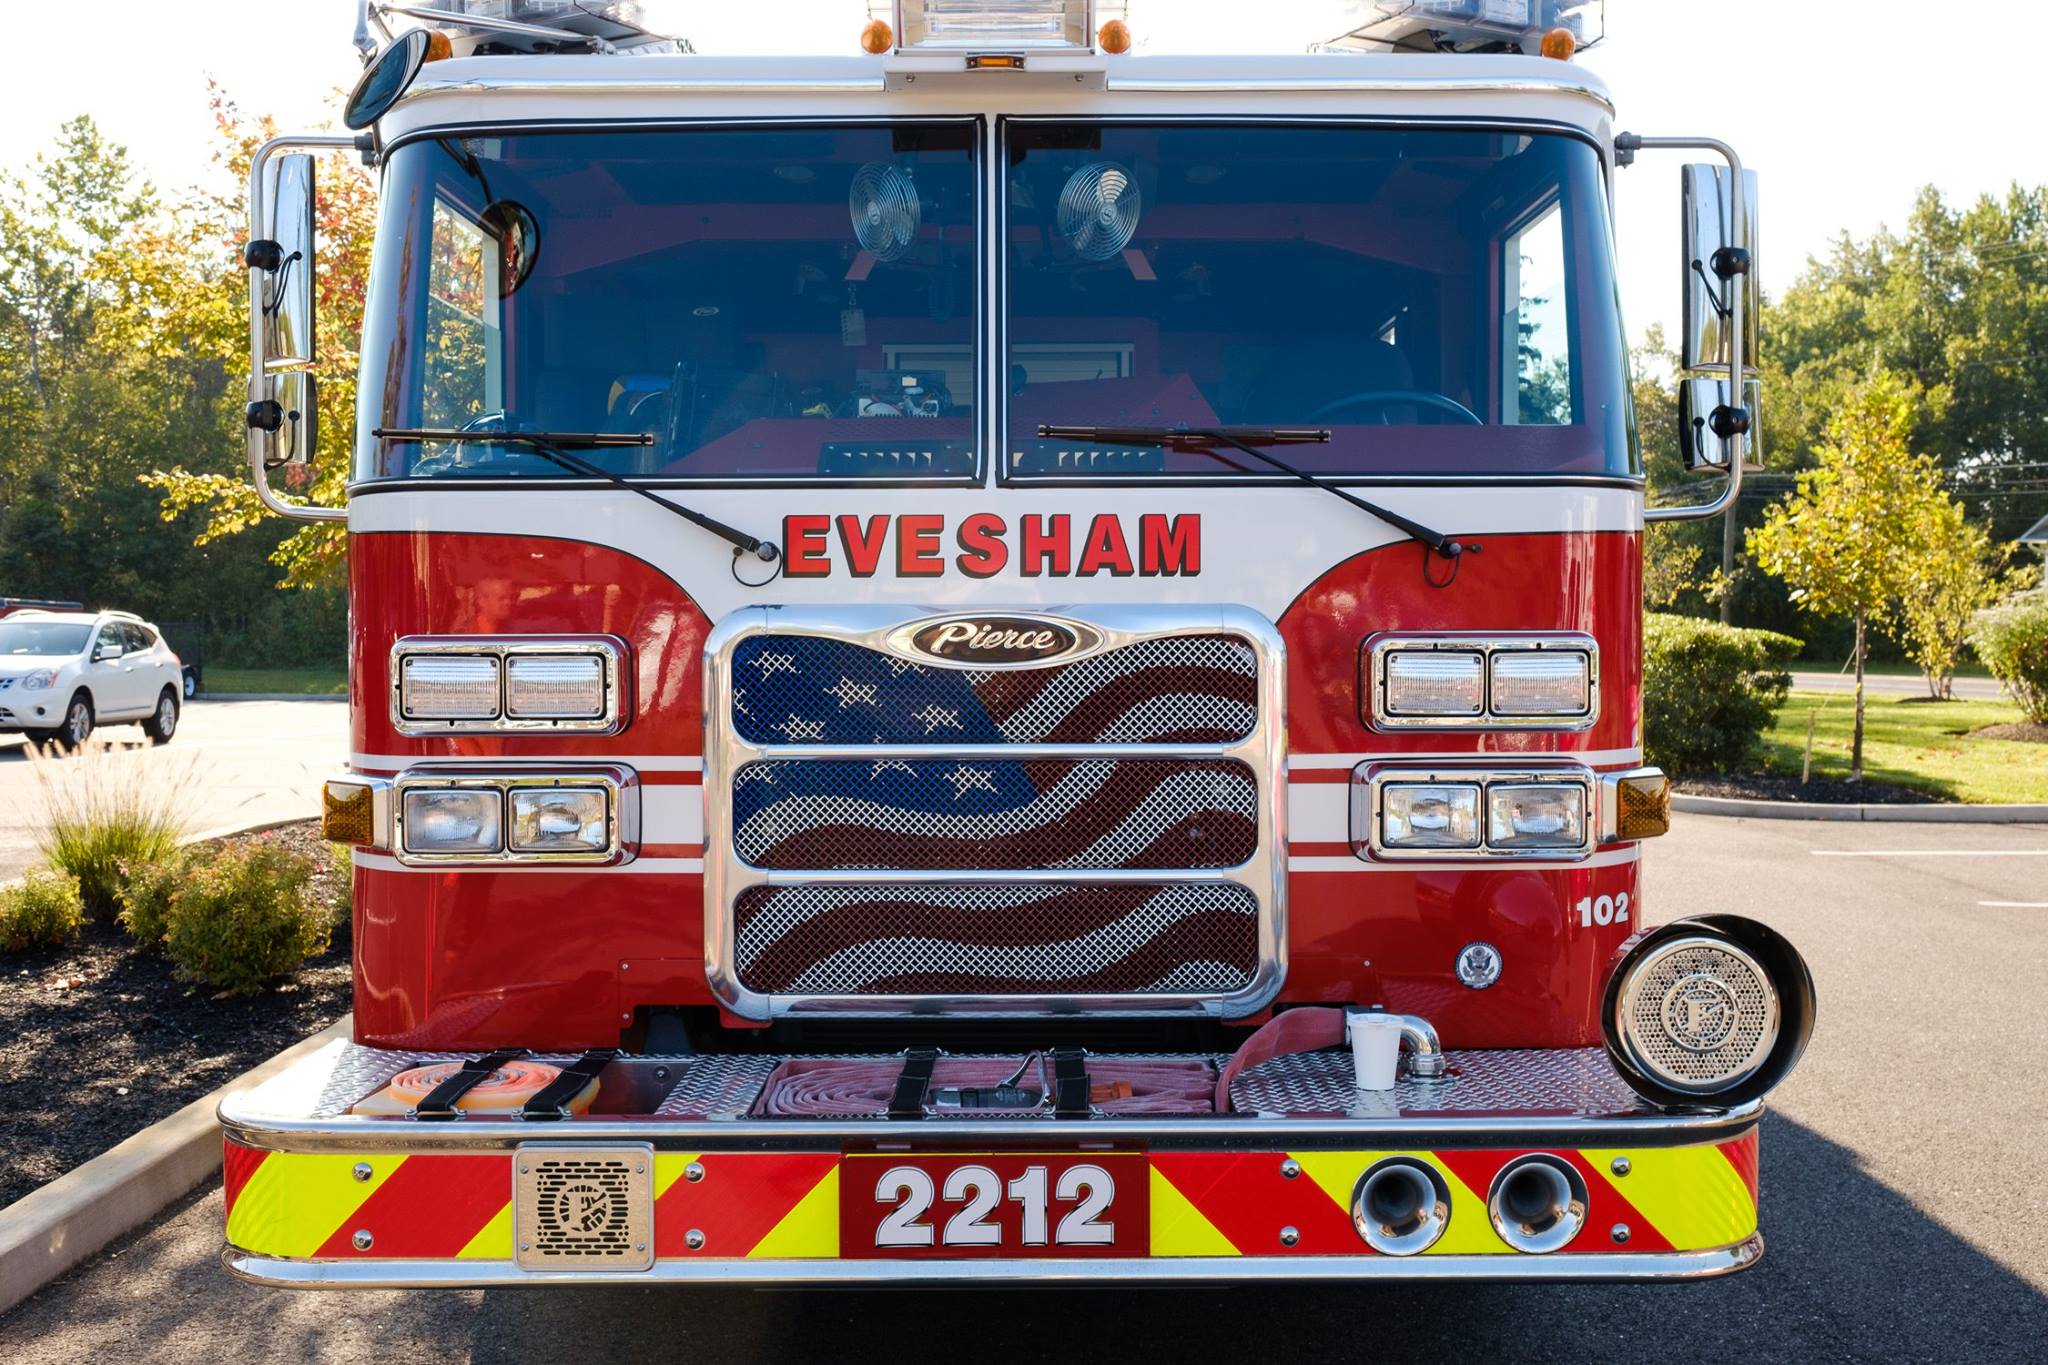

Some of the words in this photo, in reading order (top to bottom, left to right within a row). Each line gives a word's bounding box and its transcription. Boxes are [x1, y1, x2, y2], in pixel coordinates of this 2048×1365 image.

[782, 513, 1201, 578] EVESHAM
[930, 621, 1056, 654] Pierce
[1576, 891, 1629, 928] 102
[875, 1164, 1115, 1247] 2212
